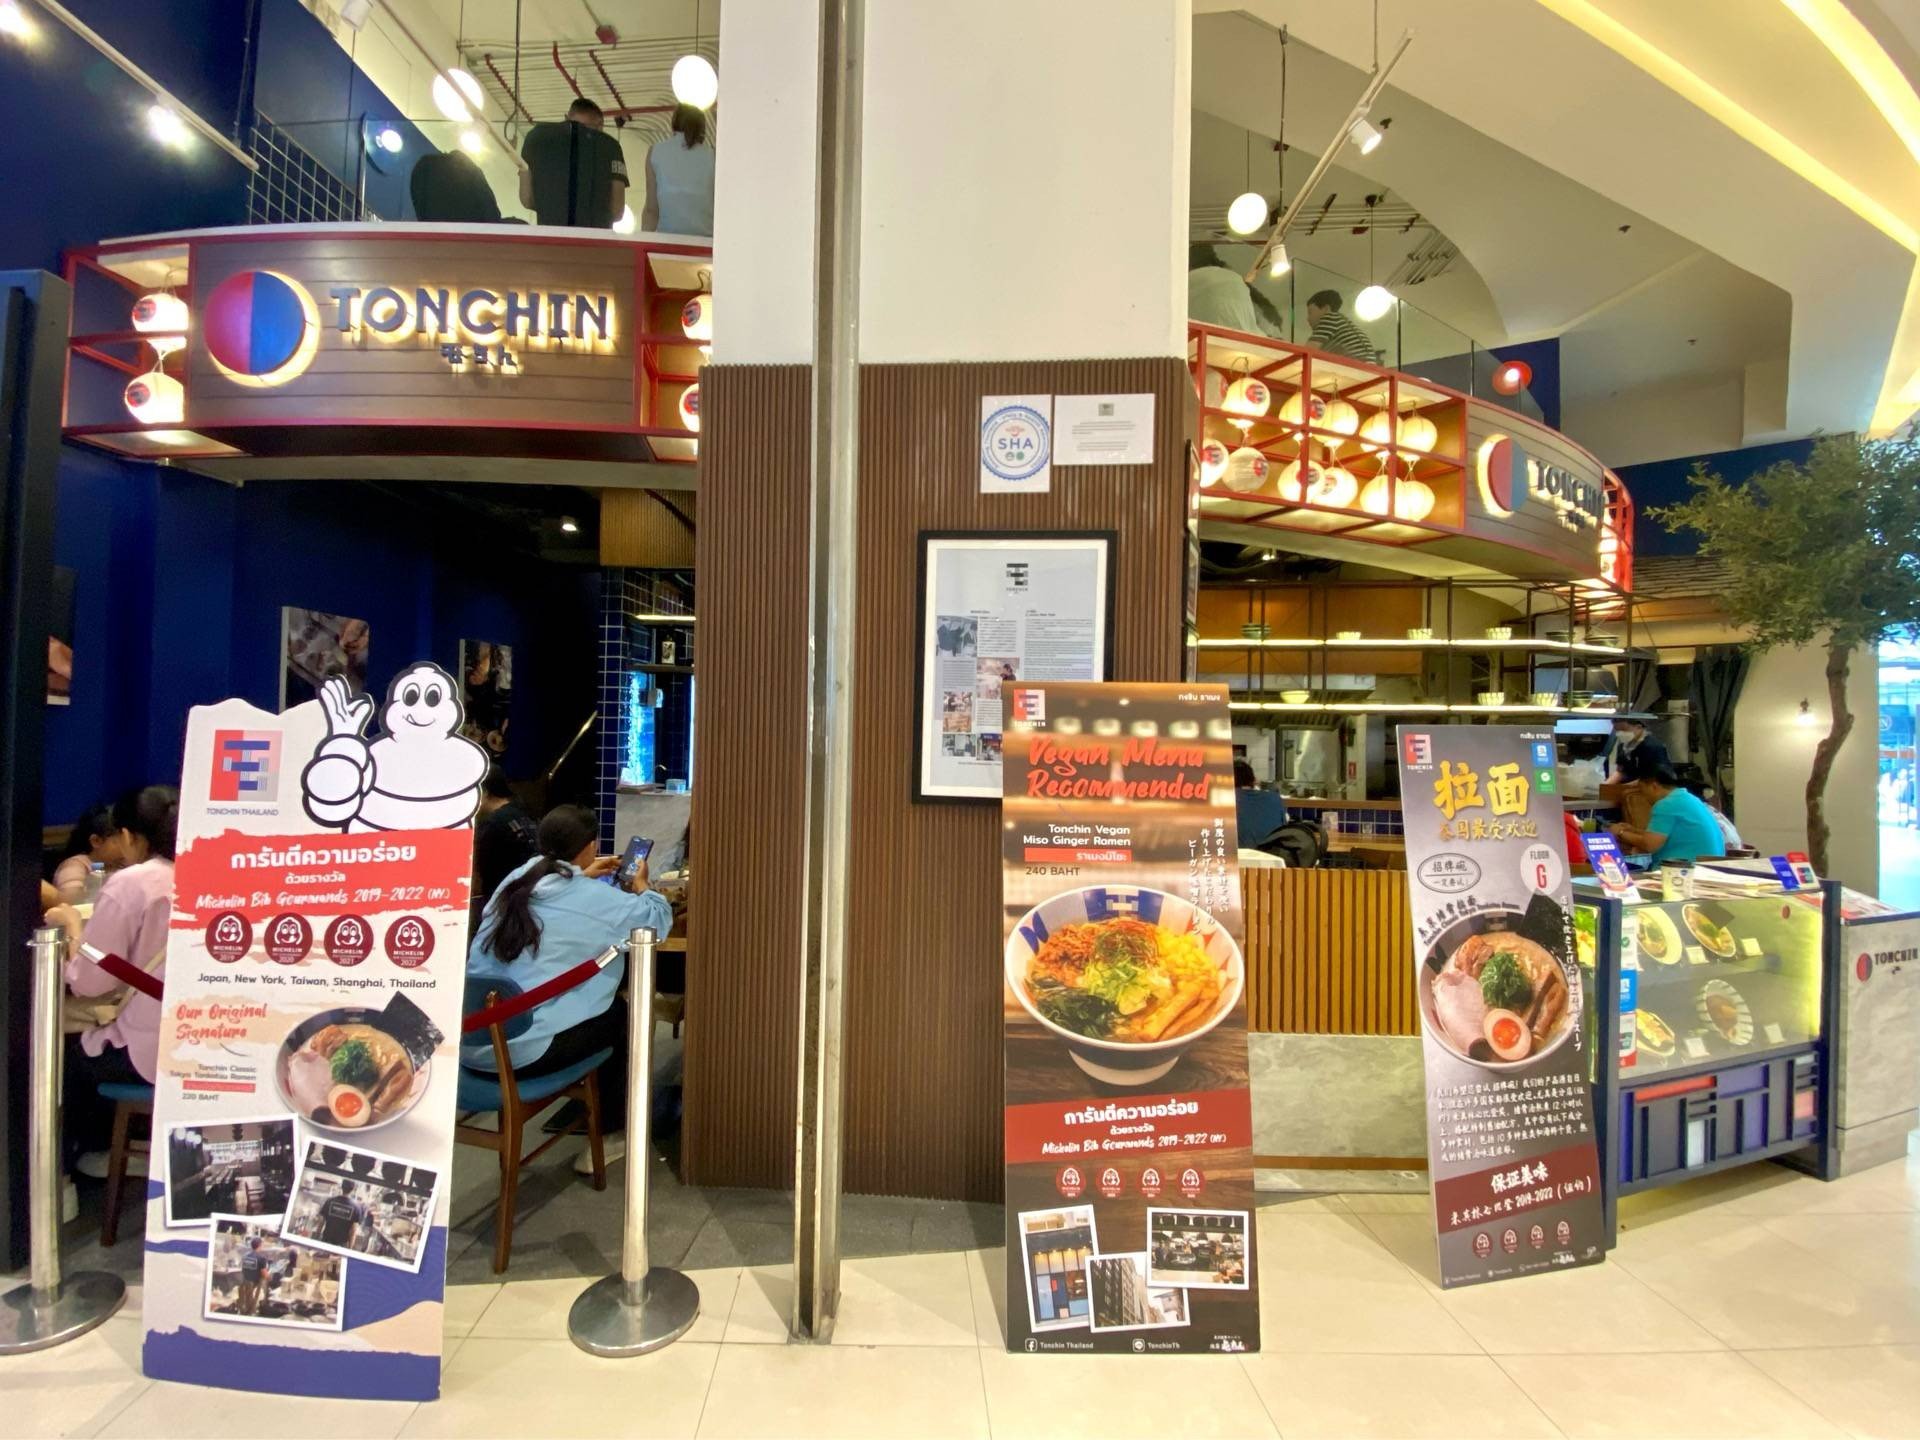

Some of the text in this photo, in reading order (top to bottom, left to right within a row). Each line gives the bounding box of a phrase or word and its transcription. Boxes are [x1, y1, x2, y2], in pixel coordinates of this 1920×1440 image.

[330, 286, 608, 340] TONCHIN
[998, 438, 1034, 450] SHA
[1028, 736, 1204, 777] Vegan Menu
[1026, 768, 1212, 800] Recommended
[1433, 759, 1530, 820] 拉面
[206, 807, 279, 816] TONCHIN THAILAND
[1048, 824, 1131, 837] Tonchin Vegan
[1023, 835, 1131, 848] Miso Ginger Ramen
[231, 843, 416, 869] การันตีความอร่อย
[1530, 850, 1549, 859] FLOOR
[1025, 866, 1081, 876] 240 BAHT
[1536, 864, 1547, 888] G
[195, 893, 246, 909] Michelin
[1874, 947, 1919, 966] TONCHIN
[197, 973, 436, 990] Japan, New York, Taiwan, Shanghai, Thailand
[176, 1003, 268, 1023] Our Original
[176, 1023, 247, 1044] Signature
[1064, 1097, 1198, 1125] การันตีความอร่อย
[1491, 1161, 1549, 1194] 保证美味
[1040, 1341, 1094, 1349] Tonchin Thailand
